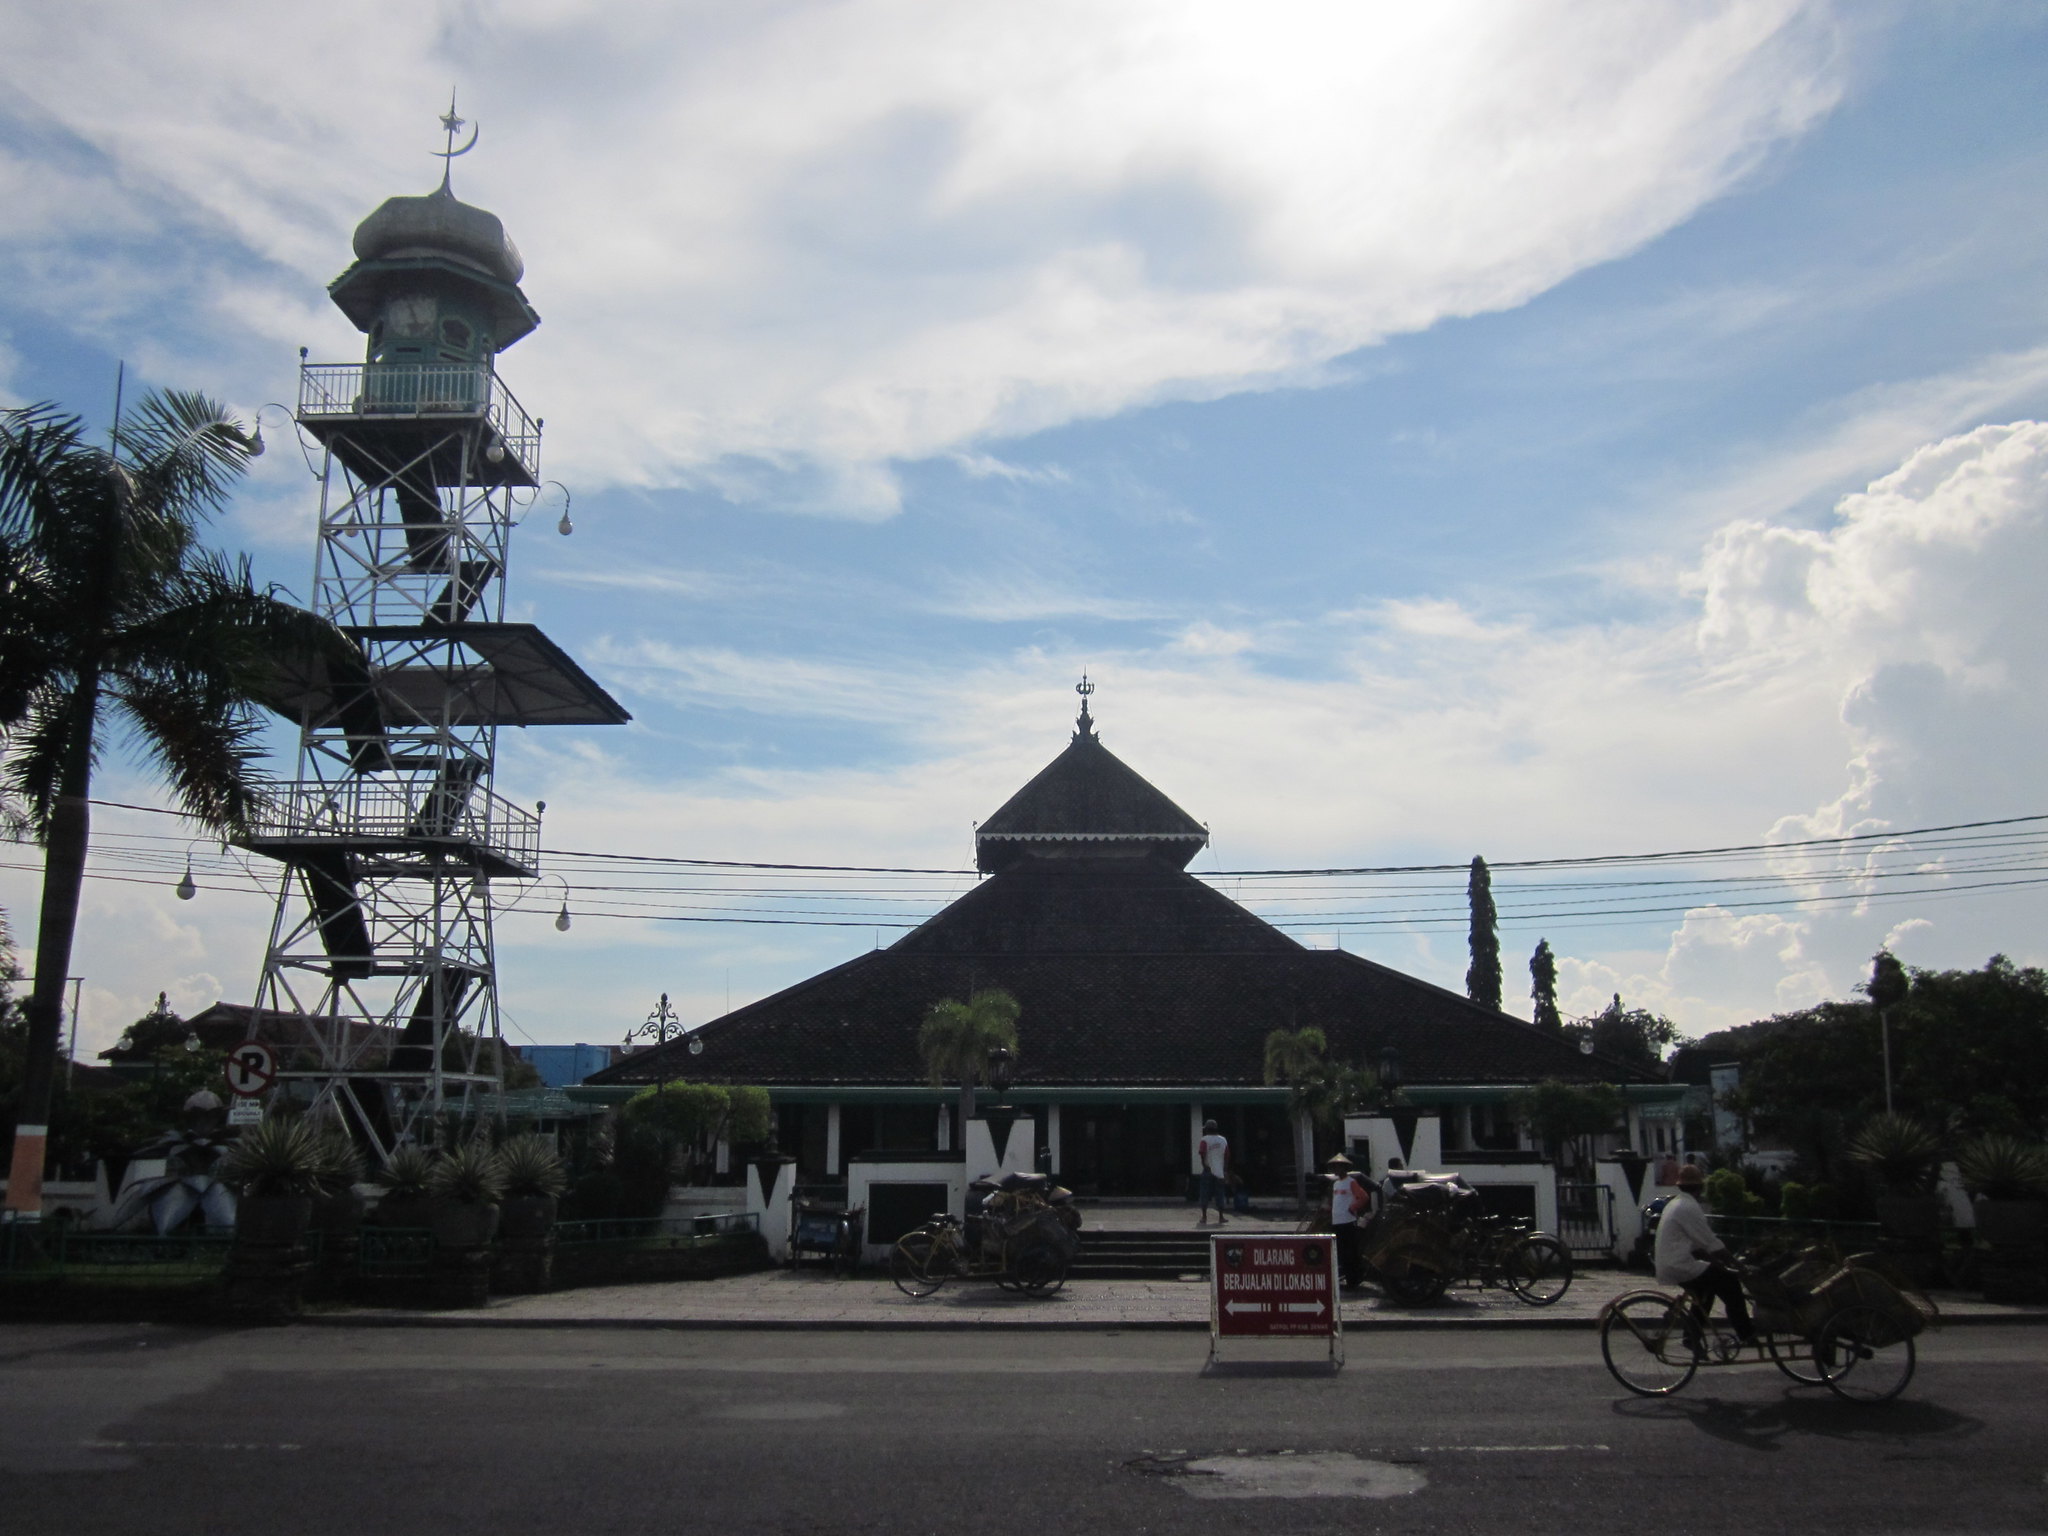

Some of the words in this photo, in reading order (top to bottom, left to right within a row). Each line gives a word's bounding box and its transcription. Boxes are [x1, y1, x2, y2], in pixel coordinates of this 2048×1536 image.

[240, 1052, 264, 1084] P
[1253, 1248, 1295, 1265] DILARANG
[1224, 1273, 1272, 1290] BERJUALAN
[1274, 1273, 1282, 1290] DI
[1284, 1273, 1313, 1290] LOKASI
[1315, 1273, 1326, 1290] INI
